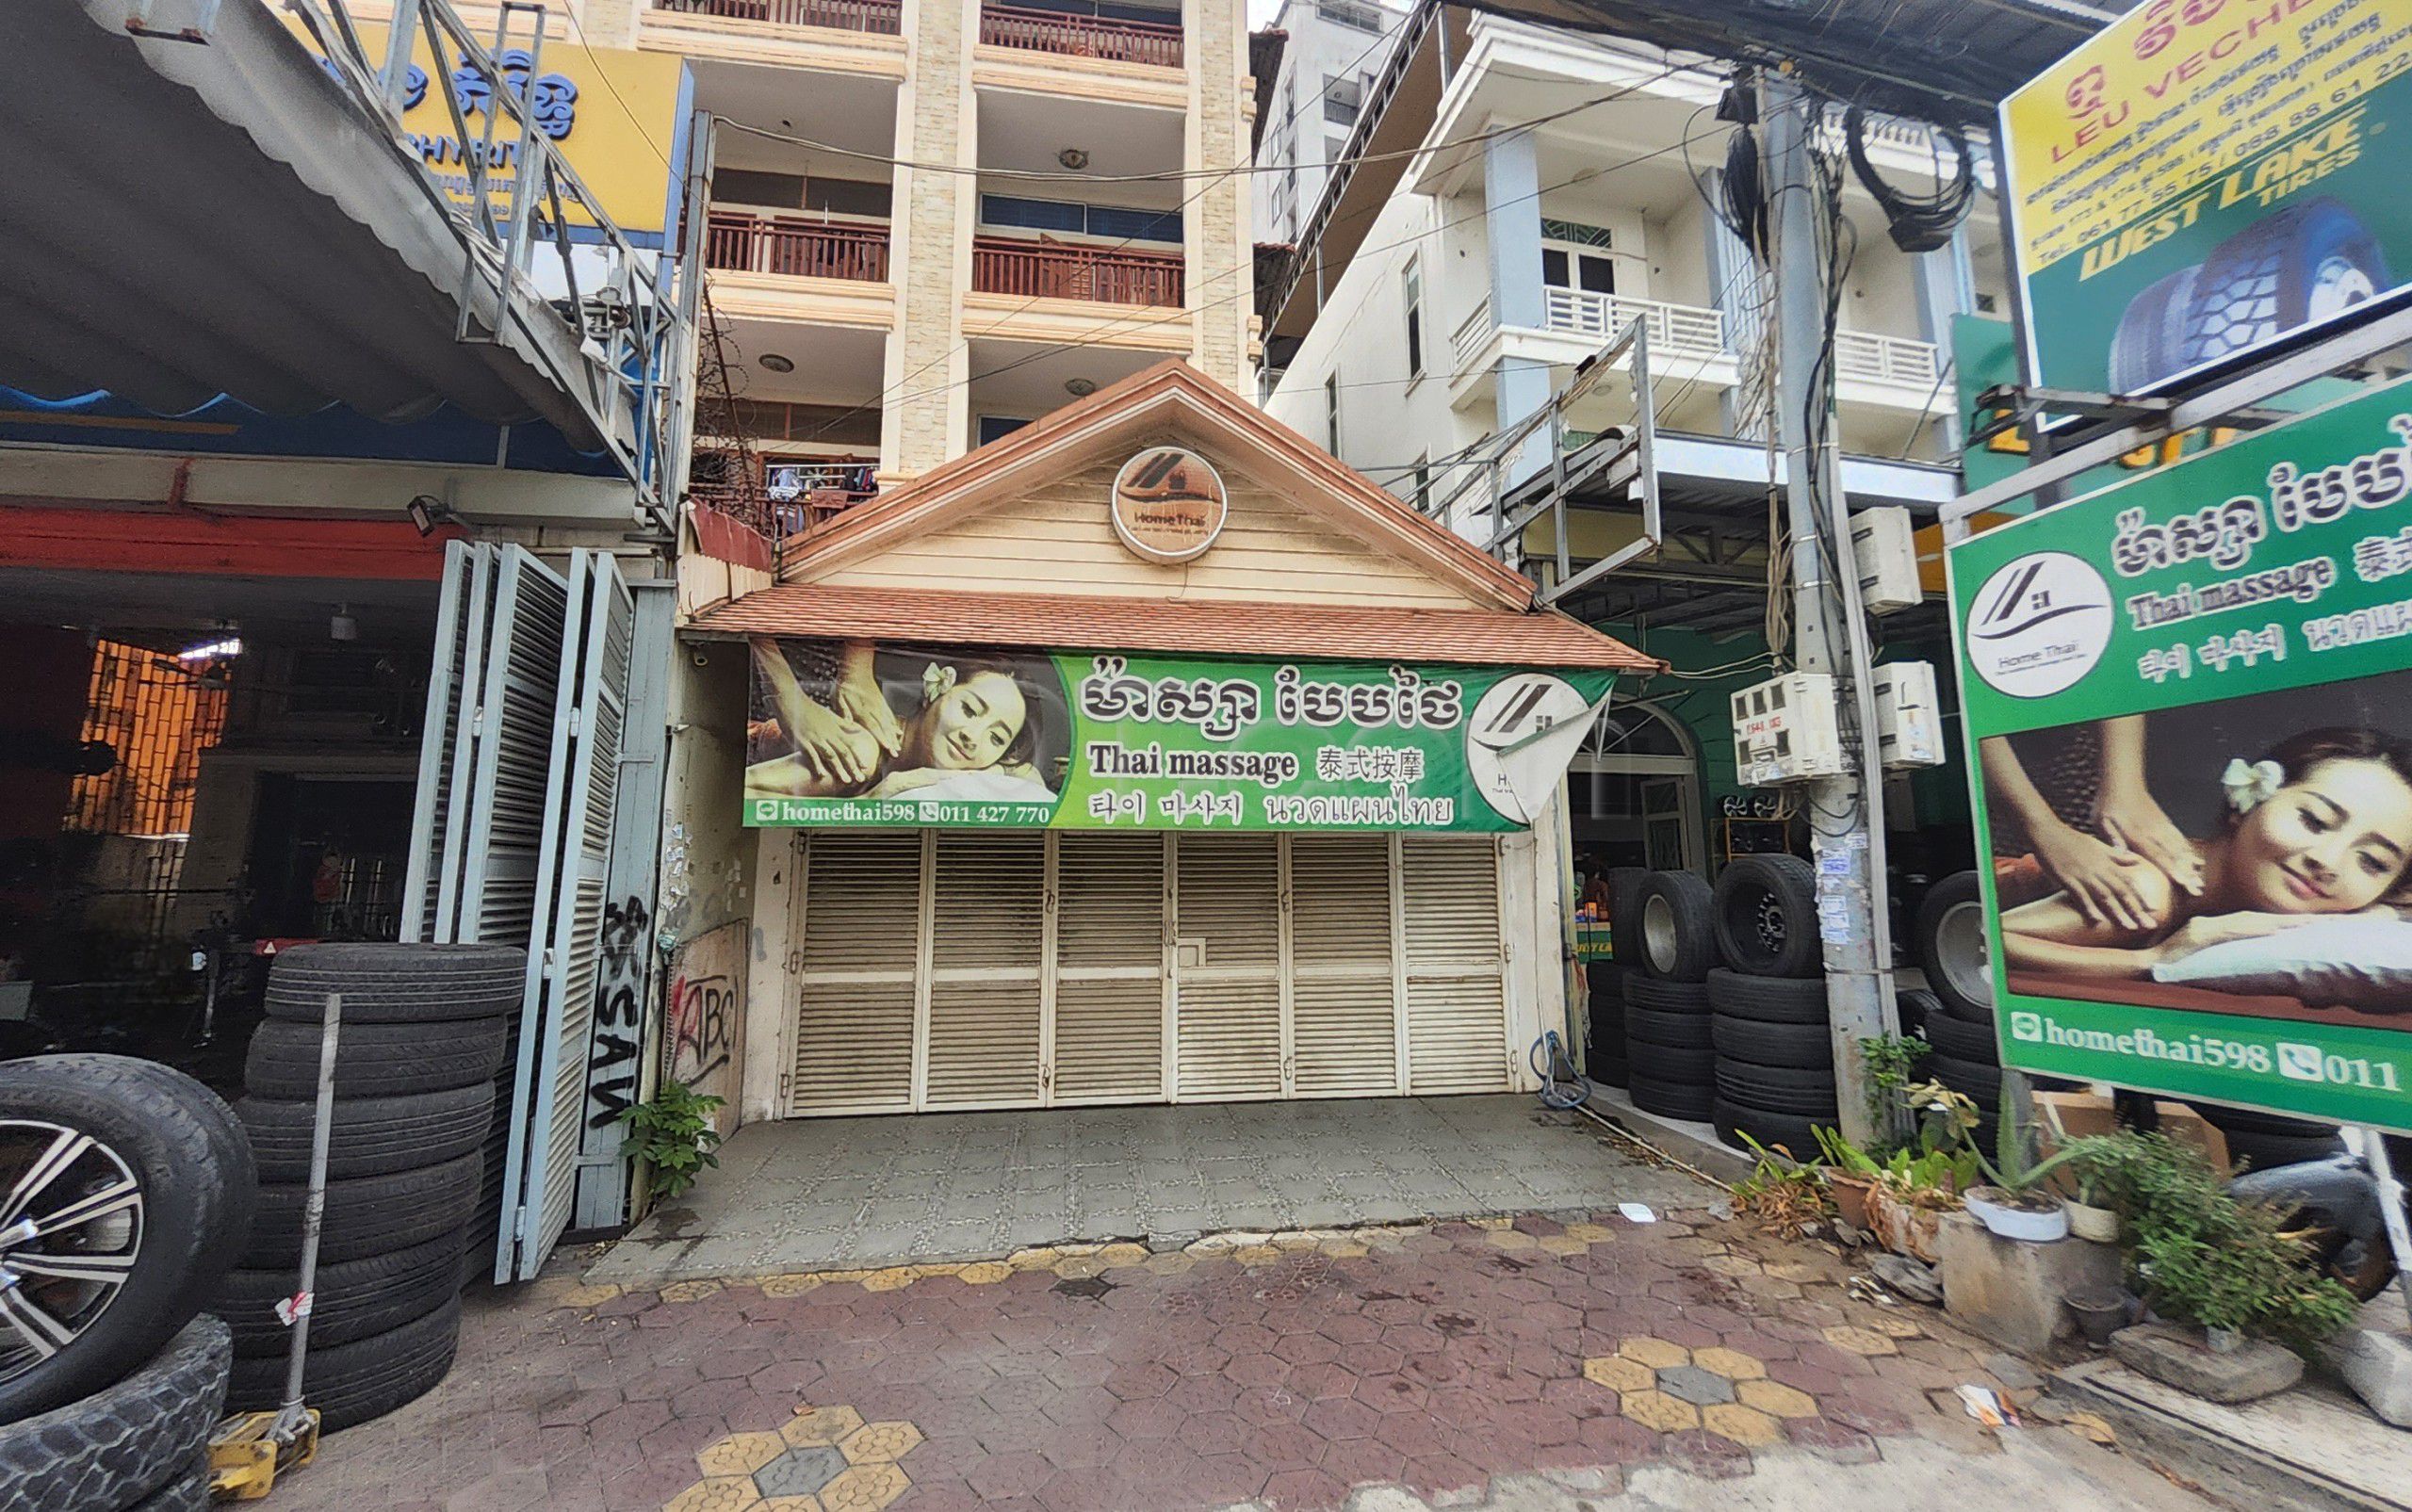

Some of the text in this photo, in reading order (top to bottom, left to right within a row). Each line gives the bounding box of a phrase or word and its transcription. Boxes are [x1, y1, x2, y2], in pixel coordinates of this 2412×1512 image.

[2331, 79, 2363, 105] 61
[2051, 100, 2129, 163] LEU
[2079, 192, 2210, 282] WEST
[2219, 106, 2368, 210] LAKE
[2257, 143, 2363, 207] TIRES
[2128, 558, 2332, 628] Thai massage
[1089, 744, 1296, 786] Thai massage
[1318, 748, 1424, 782] 泰式按摩
[781, 801, 1051, 824] homethai598 011 427 770
[1091, 792, 1243, 825] 타이 마사지
[1263, 786, 1453, 825] นวดแผนไทย
[2045, 1016, 2403, 1093] homethai598 011
